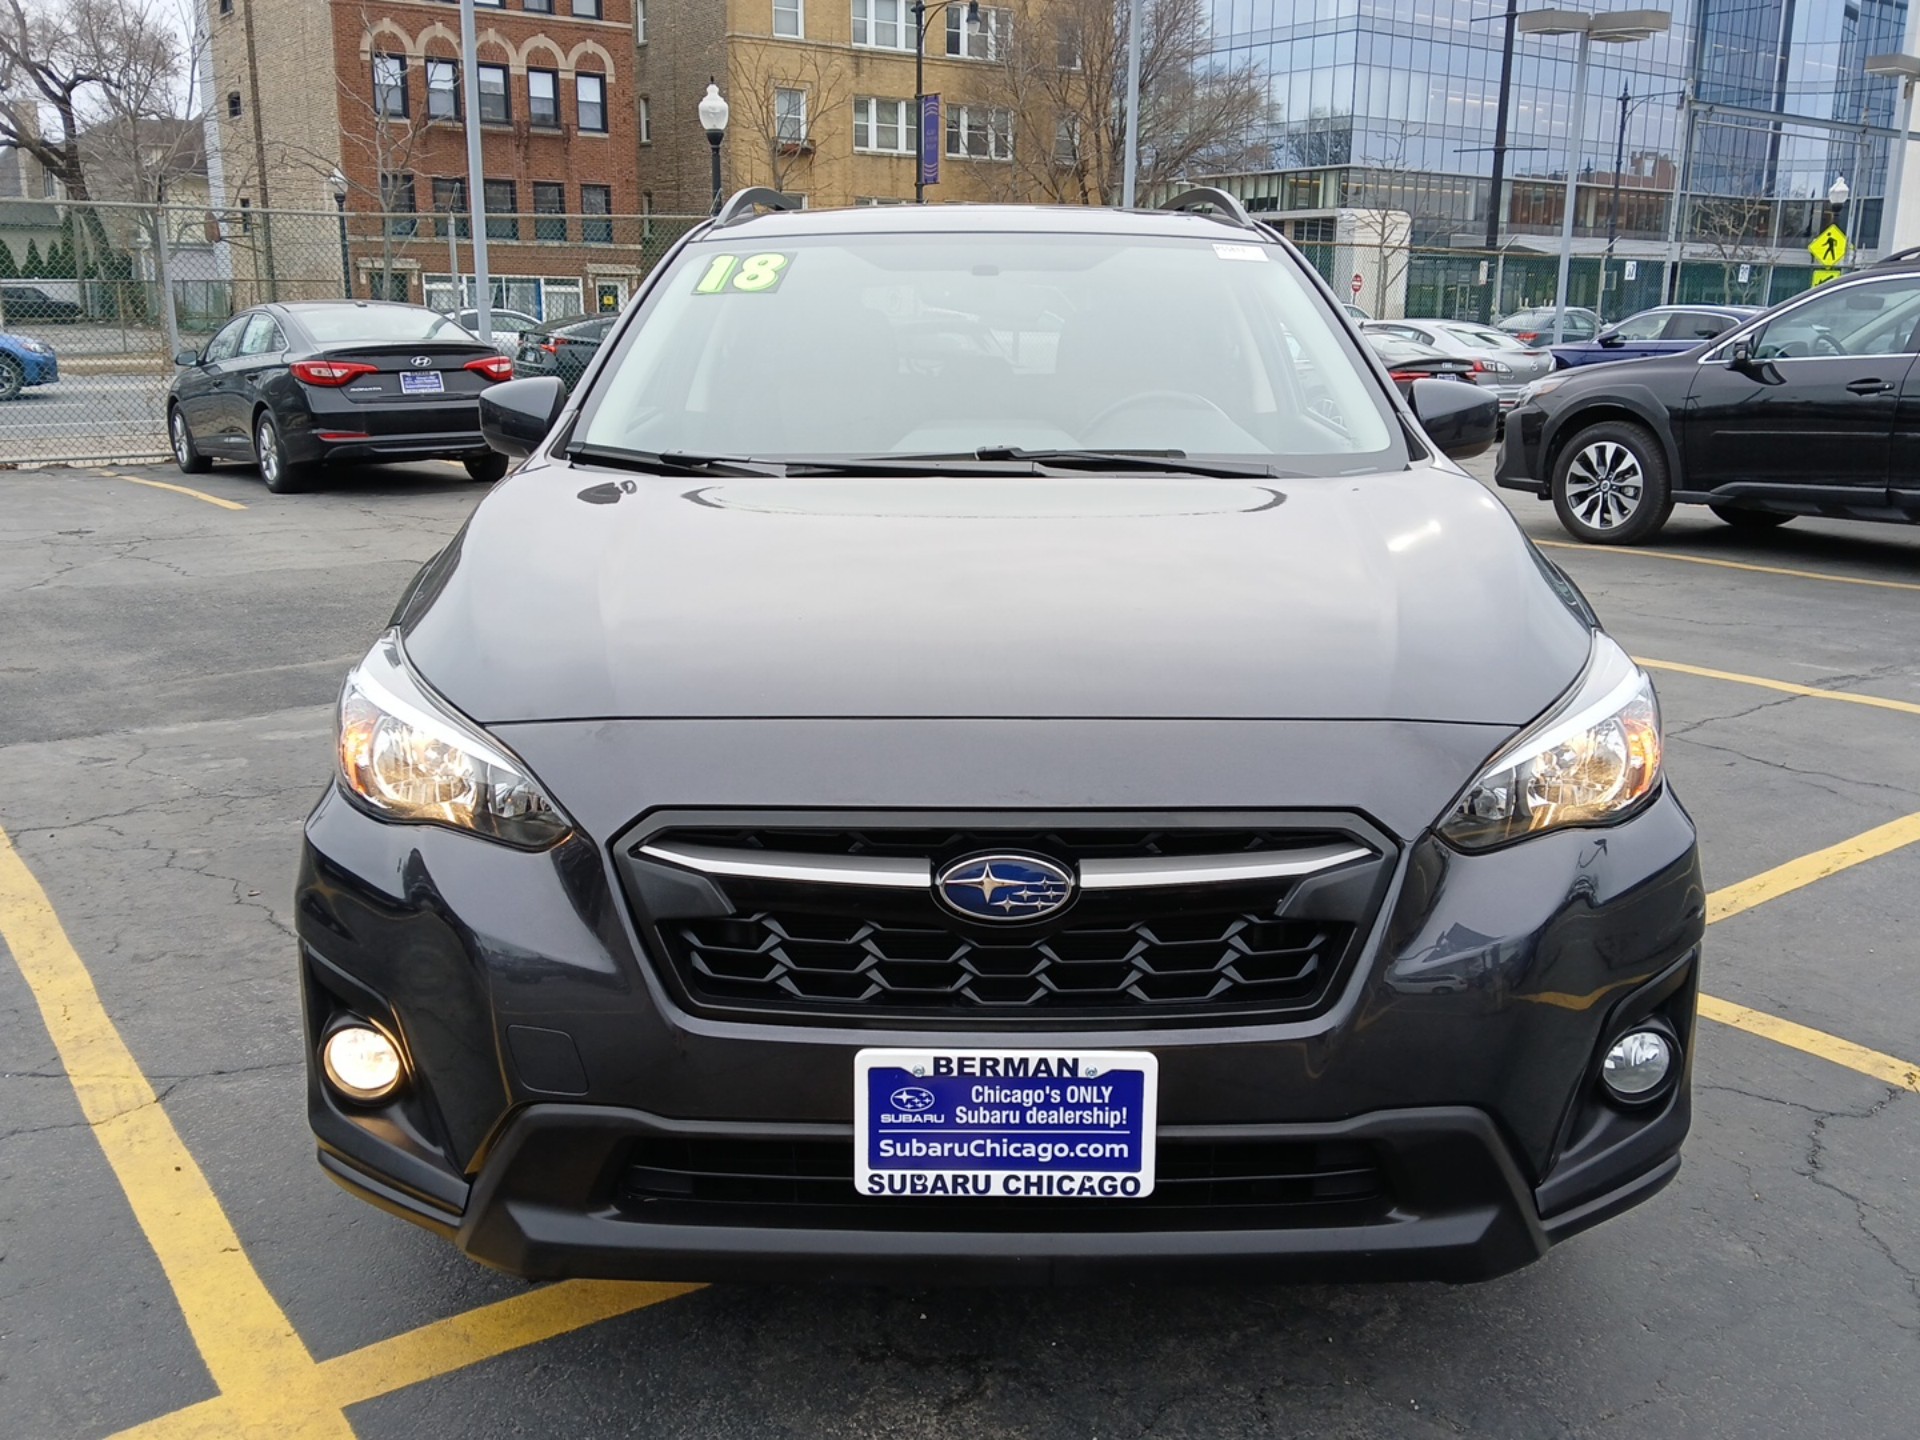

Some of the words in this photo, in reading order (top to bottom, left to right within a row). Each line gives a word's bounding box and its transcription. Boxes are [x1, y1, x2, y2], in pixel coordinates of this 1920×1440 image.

[696, 252, 788, 293] 18
[932, 1056, 1079, 1078] BERMAN
[971, 1085, 1061, 1104] Chicago's
[1066, 1085, 1113, 1104] ONLY
[880, 1113, 945, 1124] SUBARU
[955, 1106, 1020, 1125] Subaru
[1026, 1107, 1128, 1128] dealership!
[878, 1138, 1129, 1162] SubaruChicago.com
[867, 1173, 992, 1195] SUBARU
[1002, 1174, 1142, 1196] CHICAGO
